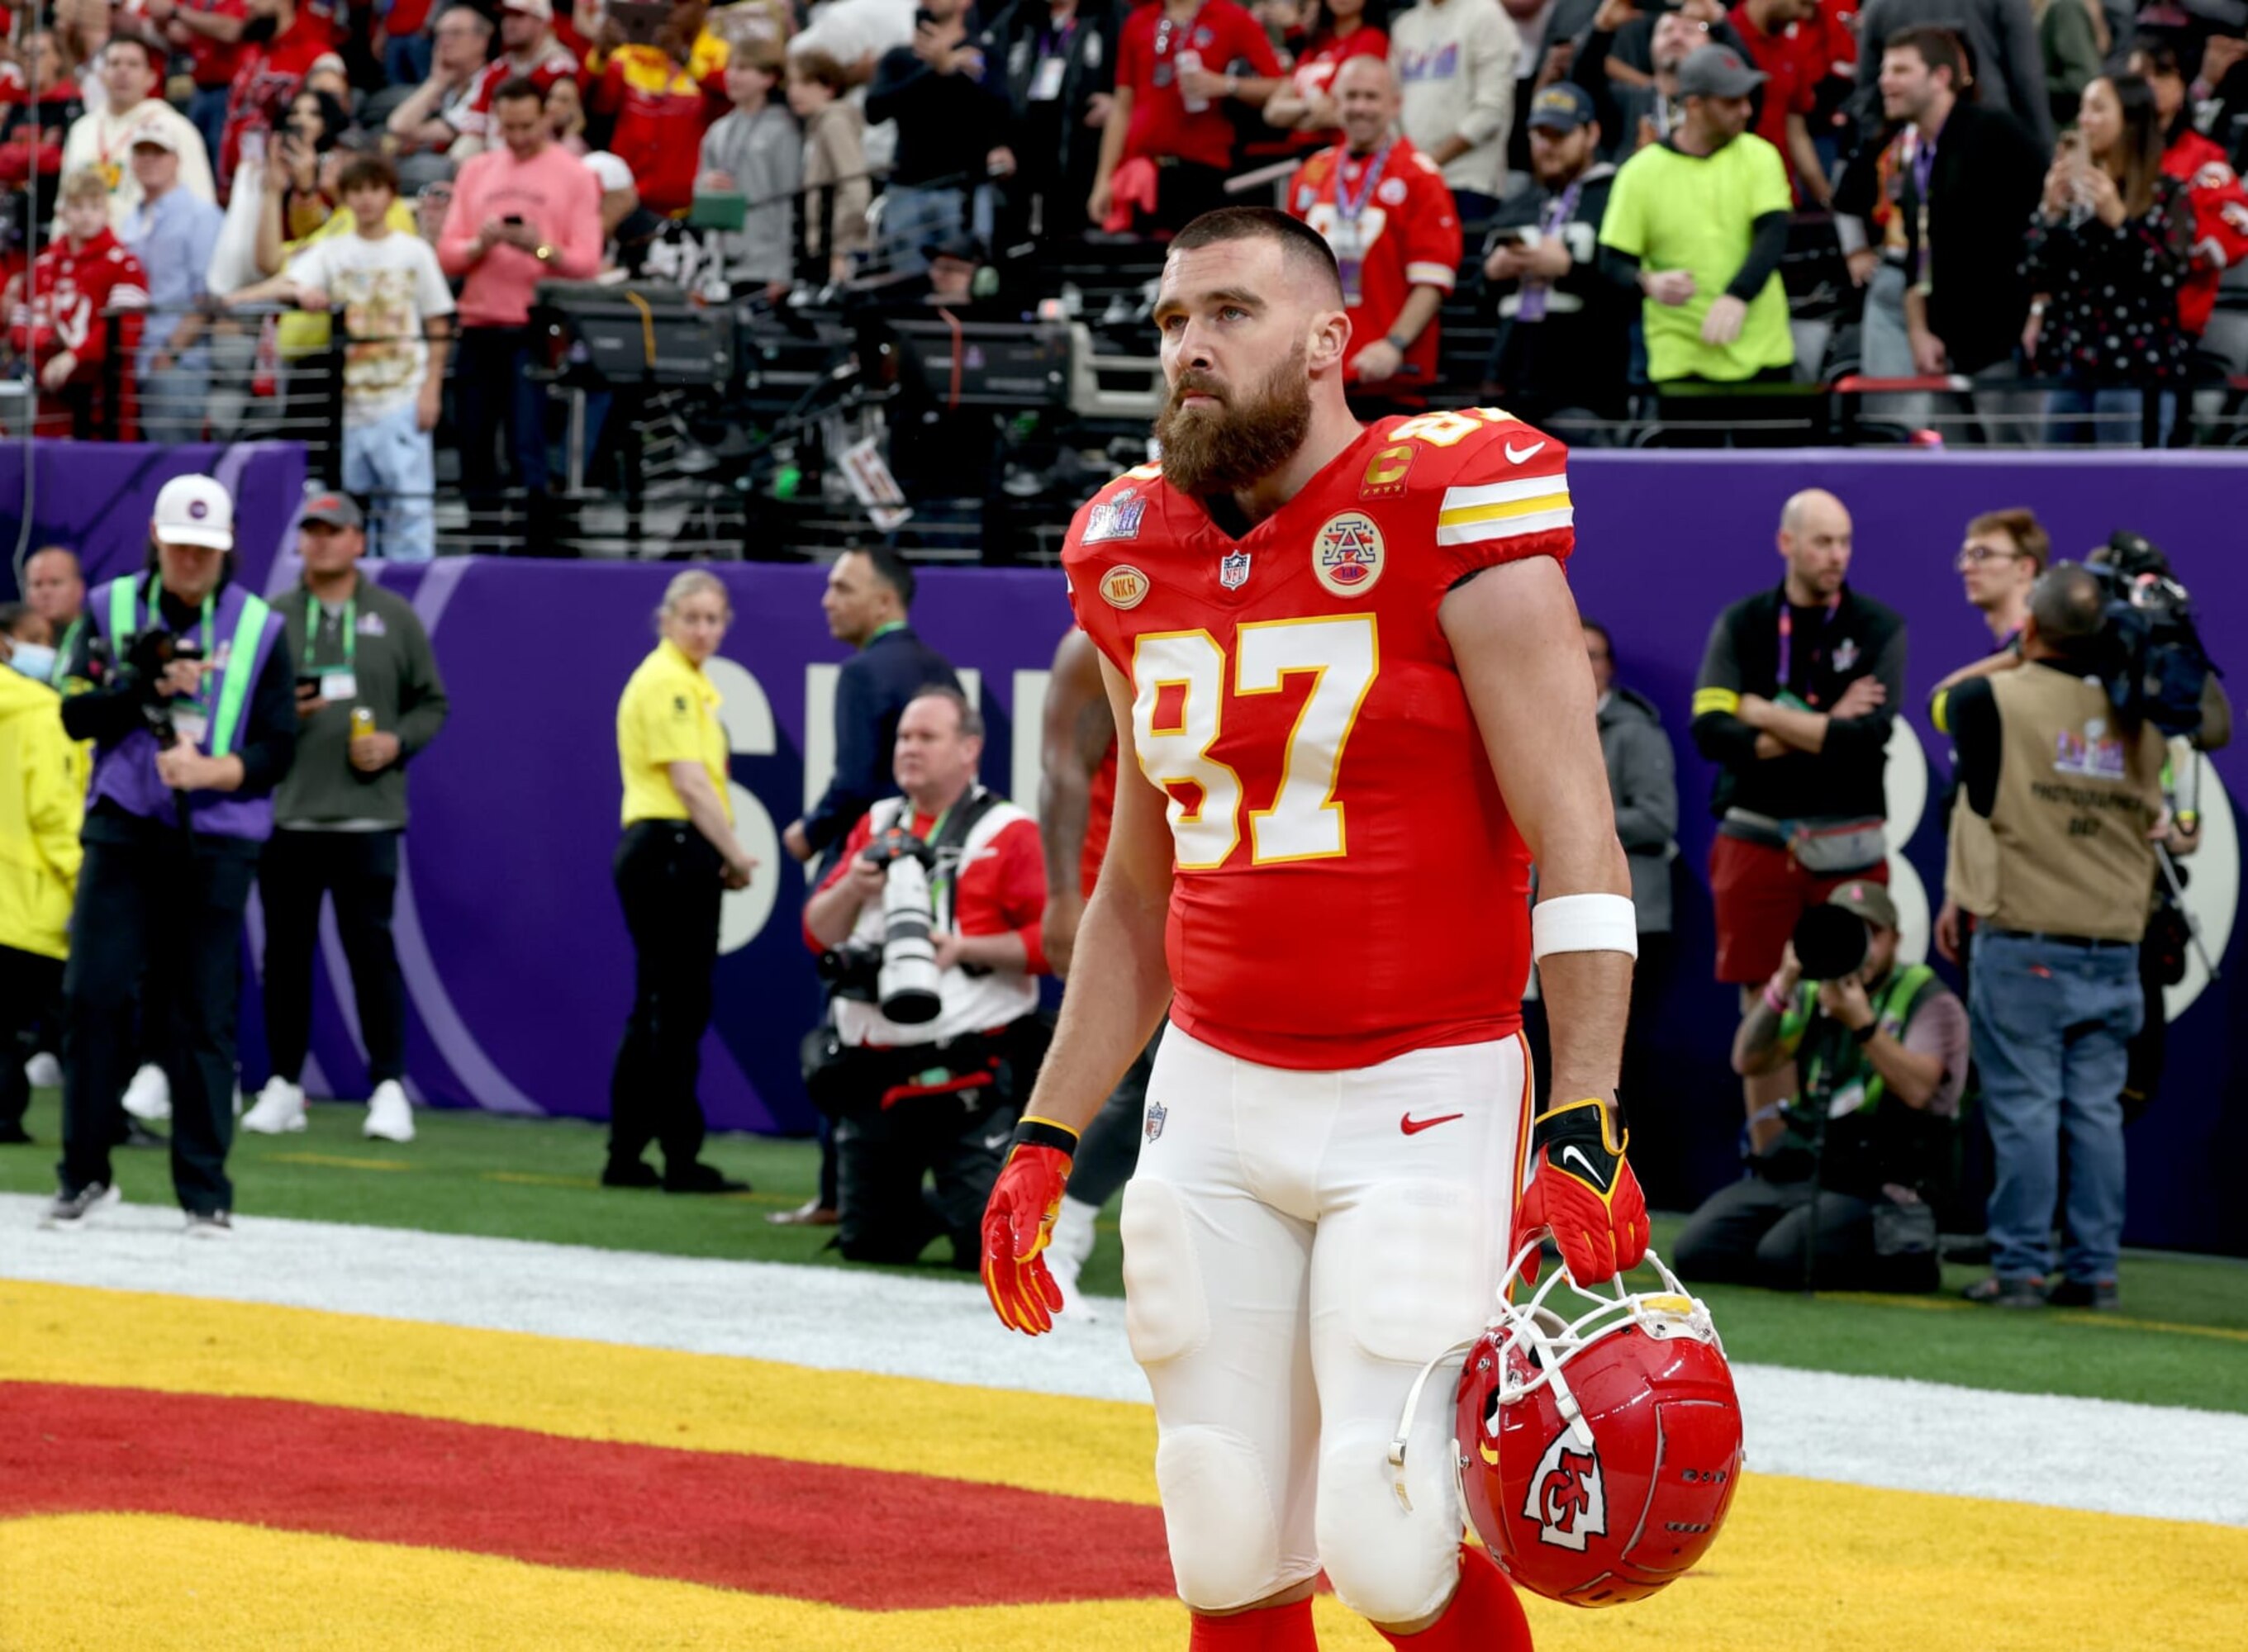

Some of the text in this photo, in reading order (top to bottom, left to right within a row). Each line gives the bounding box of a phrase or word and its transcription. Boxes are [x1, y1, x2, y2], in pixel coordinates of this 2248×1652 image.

[1366, 445, 1413, 485] C
[1323, 521, 1376, 565] A
[1111, 577, 1137, 597] NKH
[1225, 567, 1246, 583] NFL
[1132, 612, 1379, 870] 87
